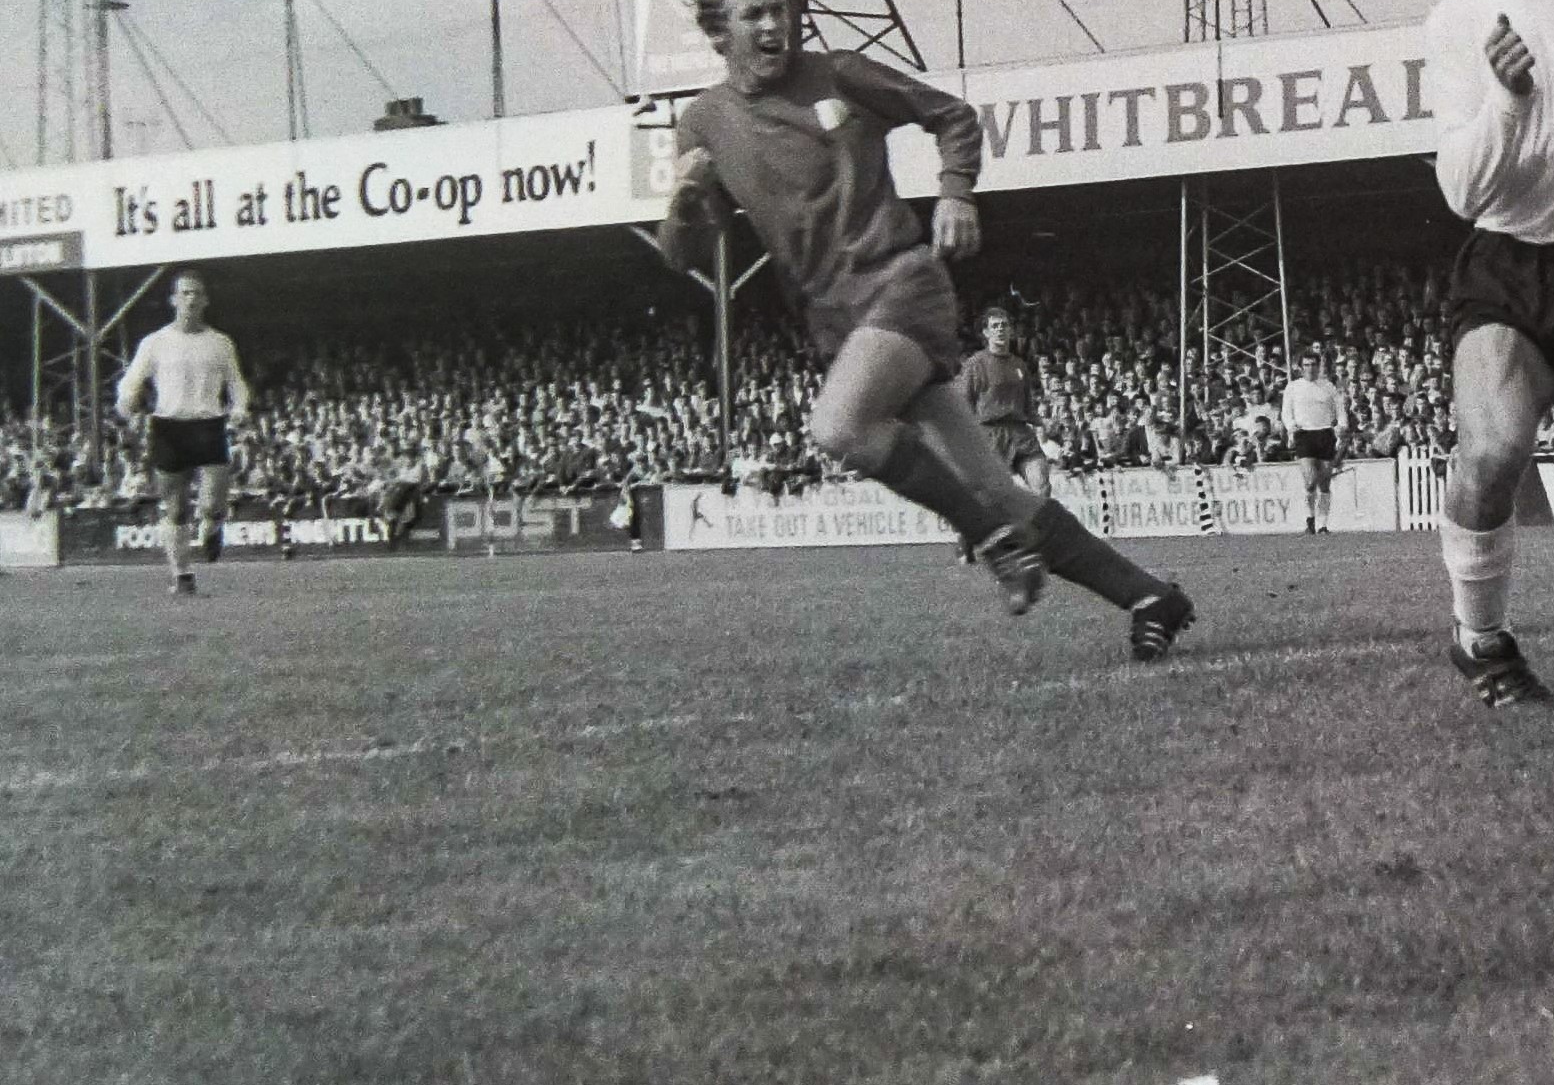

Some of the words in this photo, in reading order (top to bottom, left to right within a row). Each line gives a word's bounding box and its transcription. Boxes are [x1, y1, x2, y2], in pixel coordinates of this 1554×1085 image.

[114, 186, 158, 236] It's
[173, 179, 217, 232] all
[236, 182, 269, 227] at
[284, 170, 341, 223] the
[359, 161, 483, 225] Co-op
[502, 139, 597, 203] now!
[726, 514, 767, 539] TAKE
[773, 513, 809, 538] OUT
[815, 513, 828, 535] A
[833, 510, 909, 537] VEHICLE
